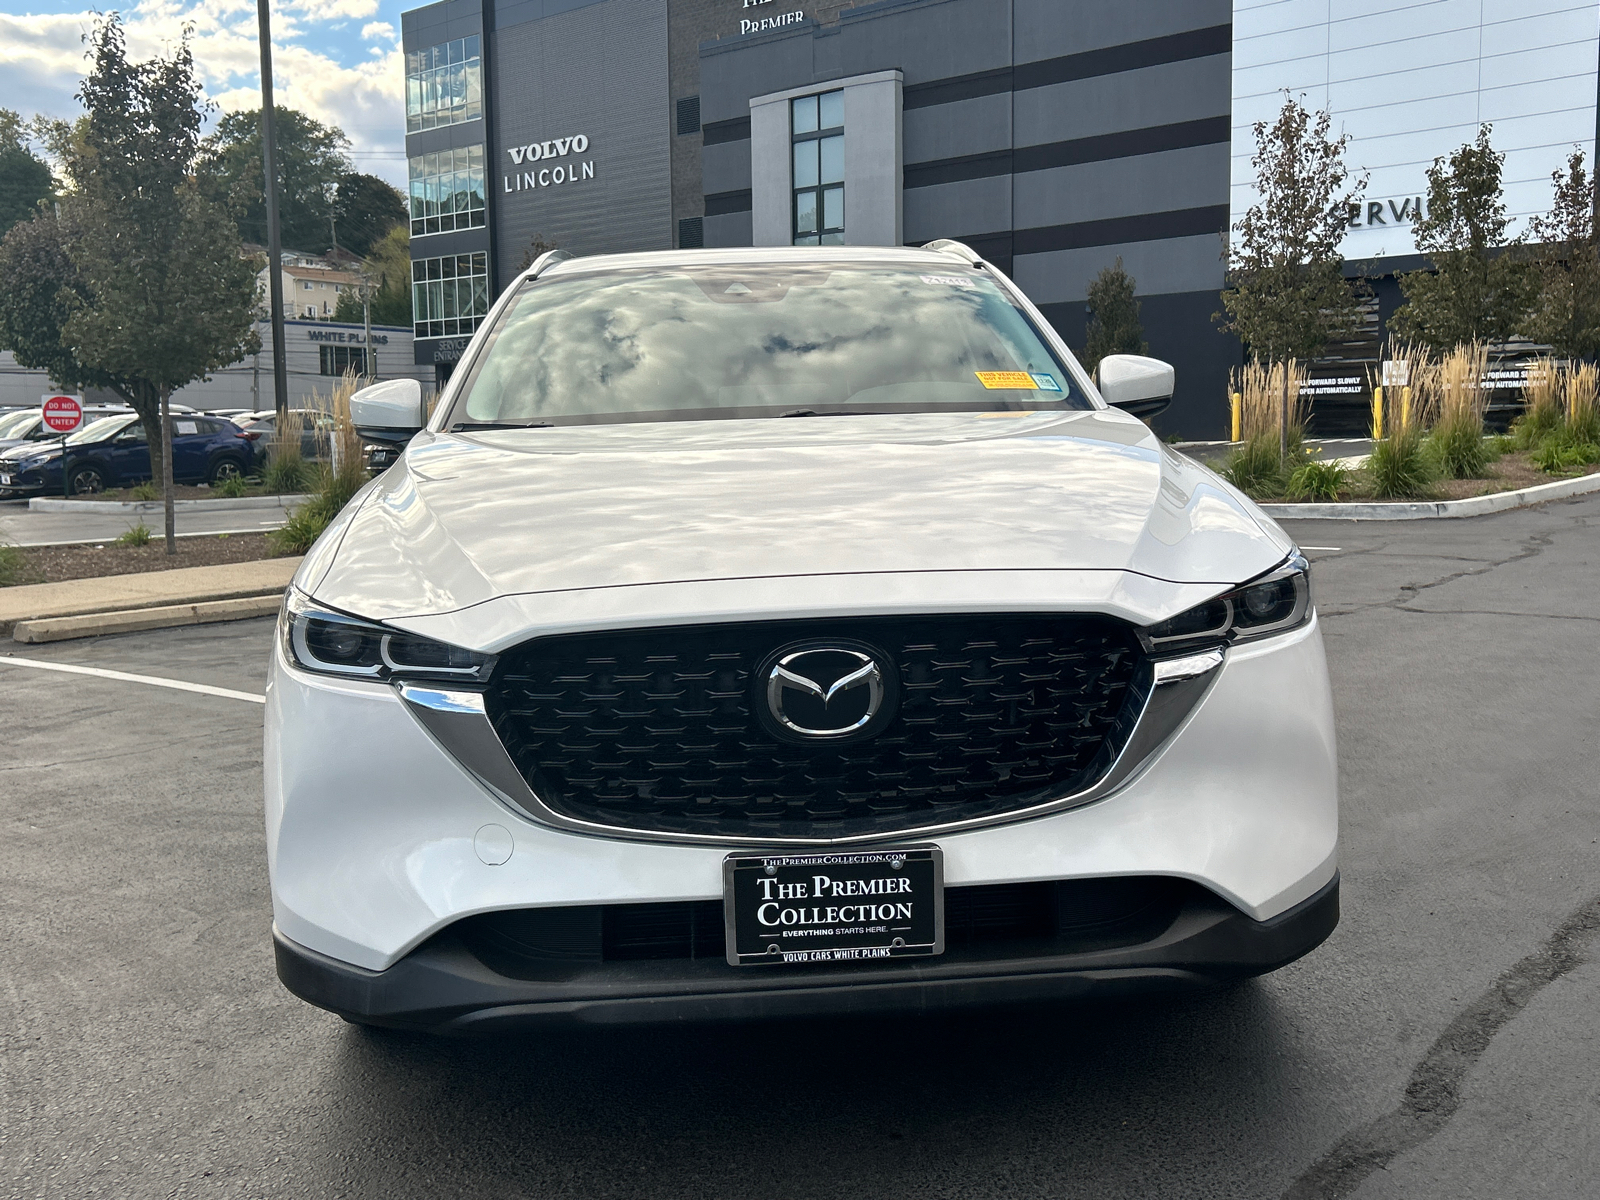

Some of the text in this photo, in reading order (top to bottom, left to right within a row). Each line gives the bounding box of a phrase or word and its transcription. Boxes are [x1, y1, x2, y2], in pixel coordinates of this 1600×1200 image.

[740, 11, 804, 35] PREMIER
[507, 134, 589, 165] VOLVO
[504, 160, 595, 193] LINCOLN
[1328, 196, 1422, 230] SERVI
[308, 330, 346, 342] WHITE
[438, 339, 467, 351] SERVICE
[434, 349, 464, 362] ENTRAN
[1308, 378, 1336, 386] FORWARD
[1337, 377, 1361, 385] SLOWLY
[1299, 387, 1315, 396] OPEN
[1315, 386, 1362, 395] AUTOMATICALLY
[756, 875, 913, 900] THE PREMIER
[757, 902, 913, 927] COLLECTION
[782, 926, 889, 938] EVERYTHING STARTS HERE.
[783, 948, 891, 963] VOLVO CARS WHITE PLAINS
